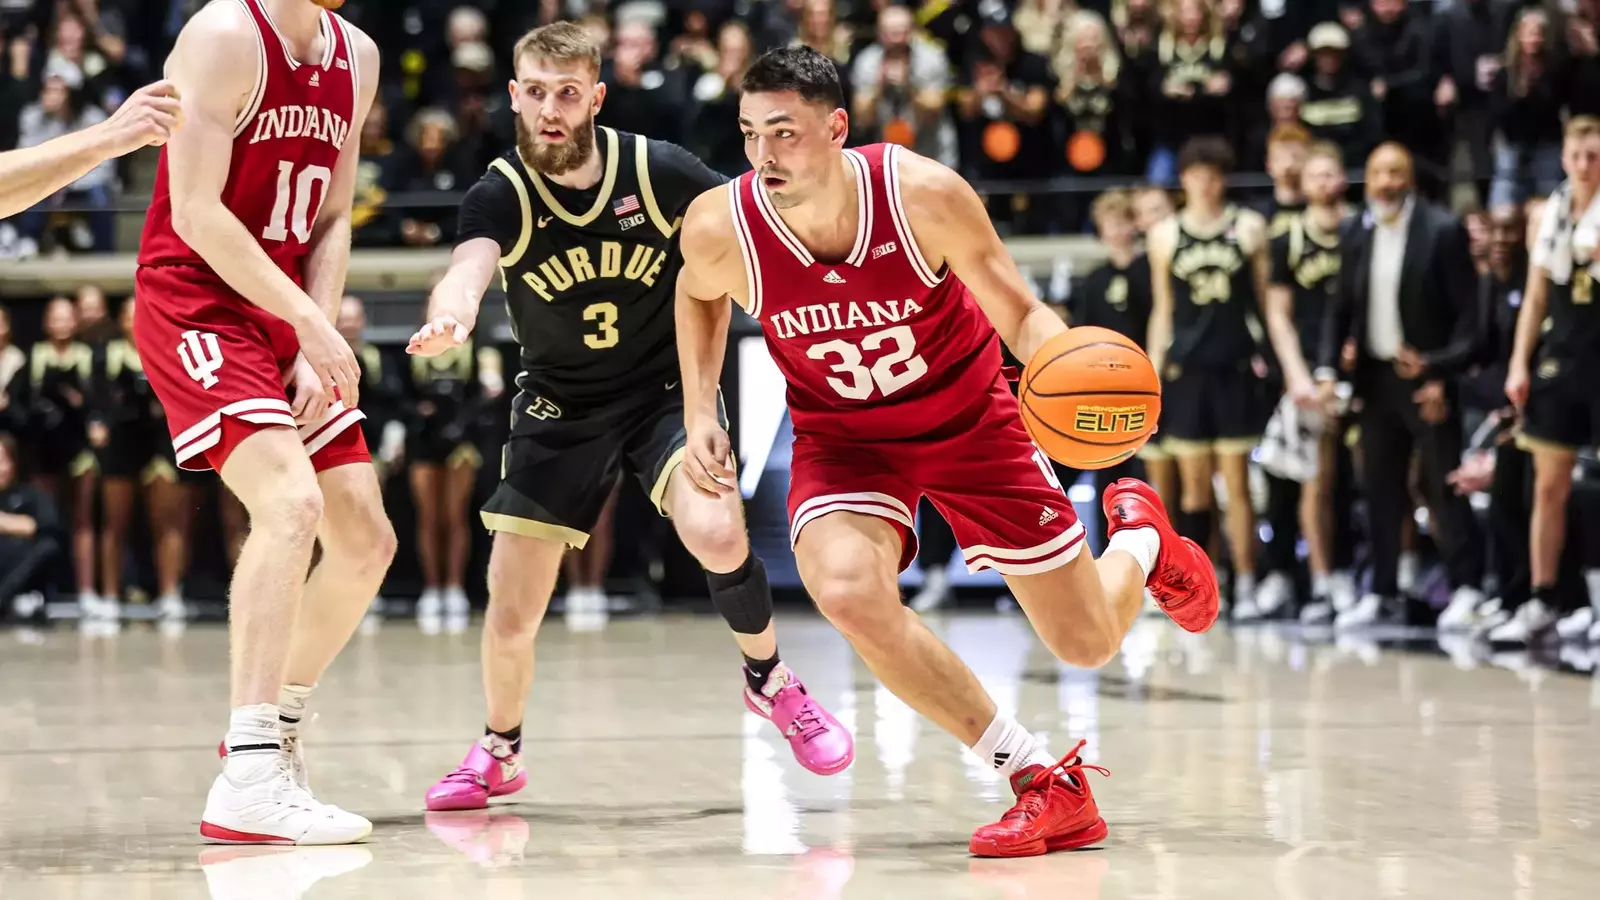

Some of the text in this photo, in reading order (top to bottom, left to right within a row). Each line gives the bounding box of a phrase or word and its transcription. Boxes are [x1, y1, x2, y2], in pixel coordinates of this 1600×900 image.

[262, 160, 331, 244] 10
[522, 241, 667, 302] PURDUE
[583, 302, 619, 349] 3
[770, 298, 923, 339] INDIANA
[805, 325, 928, 400] 32
[1074, 411, 1146, 434] ELITE
[1038, 511, 1060, 527] adidas
